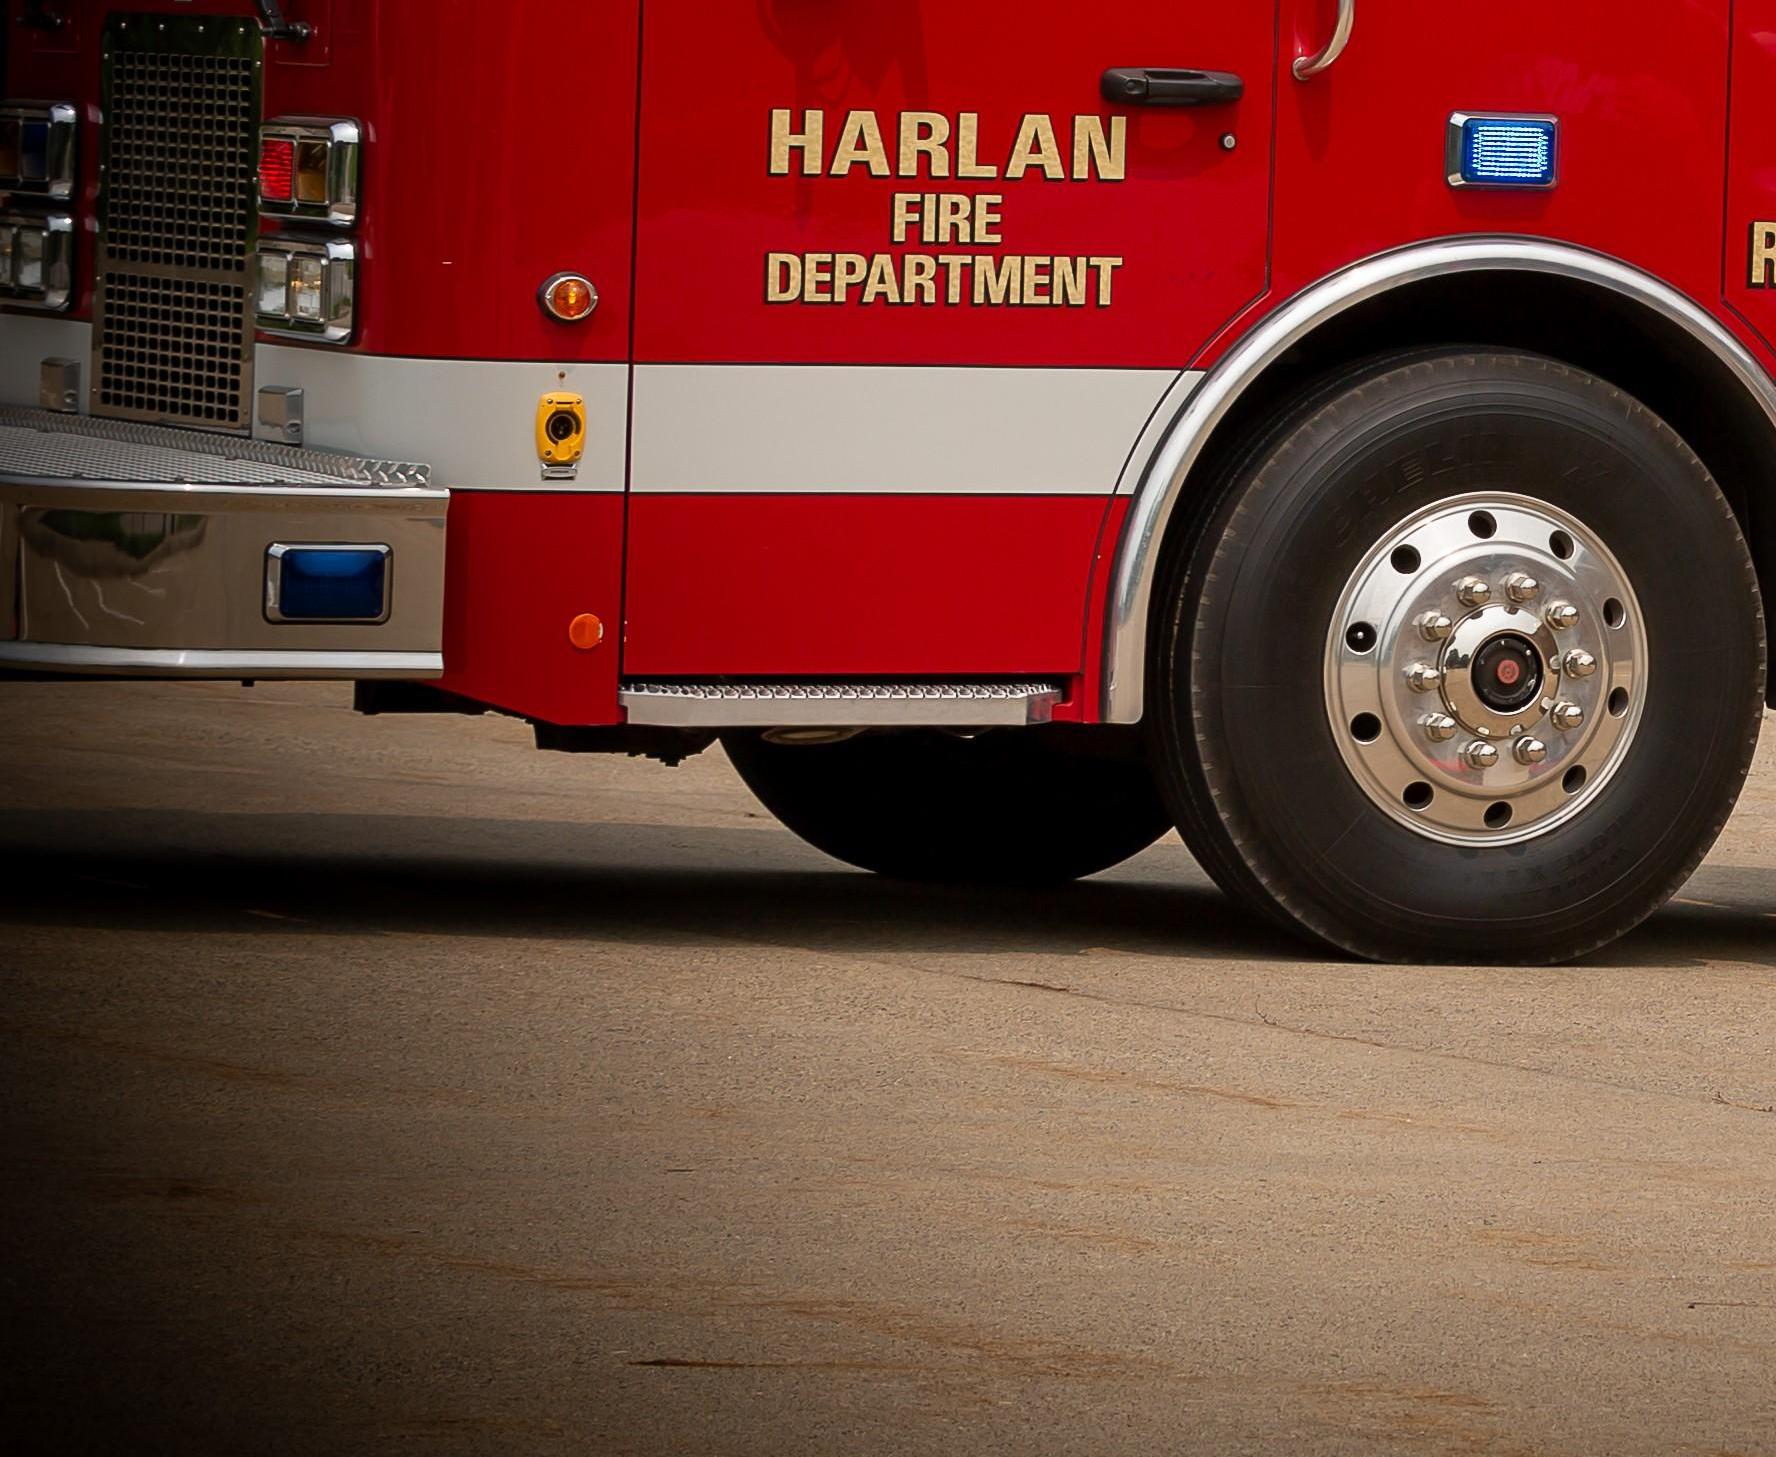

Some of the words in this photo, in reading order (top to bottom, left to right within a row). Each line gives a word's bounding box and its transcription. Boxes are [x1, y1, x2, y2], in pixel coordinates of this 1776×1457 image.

[768, 108, 1127, 181] HARLAN
[891, 192, 1003, 245] FIRE
[764, 252, 1123, 308] DEPARTMENT
